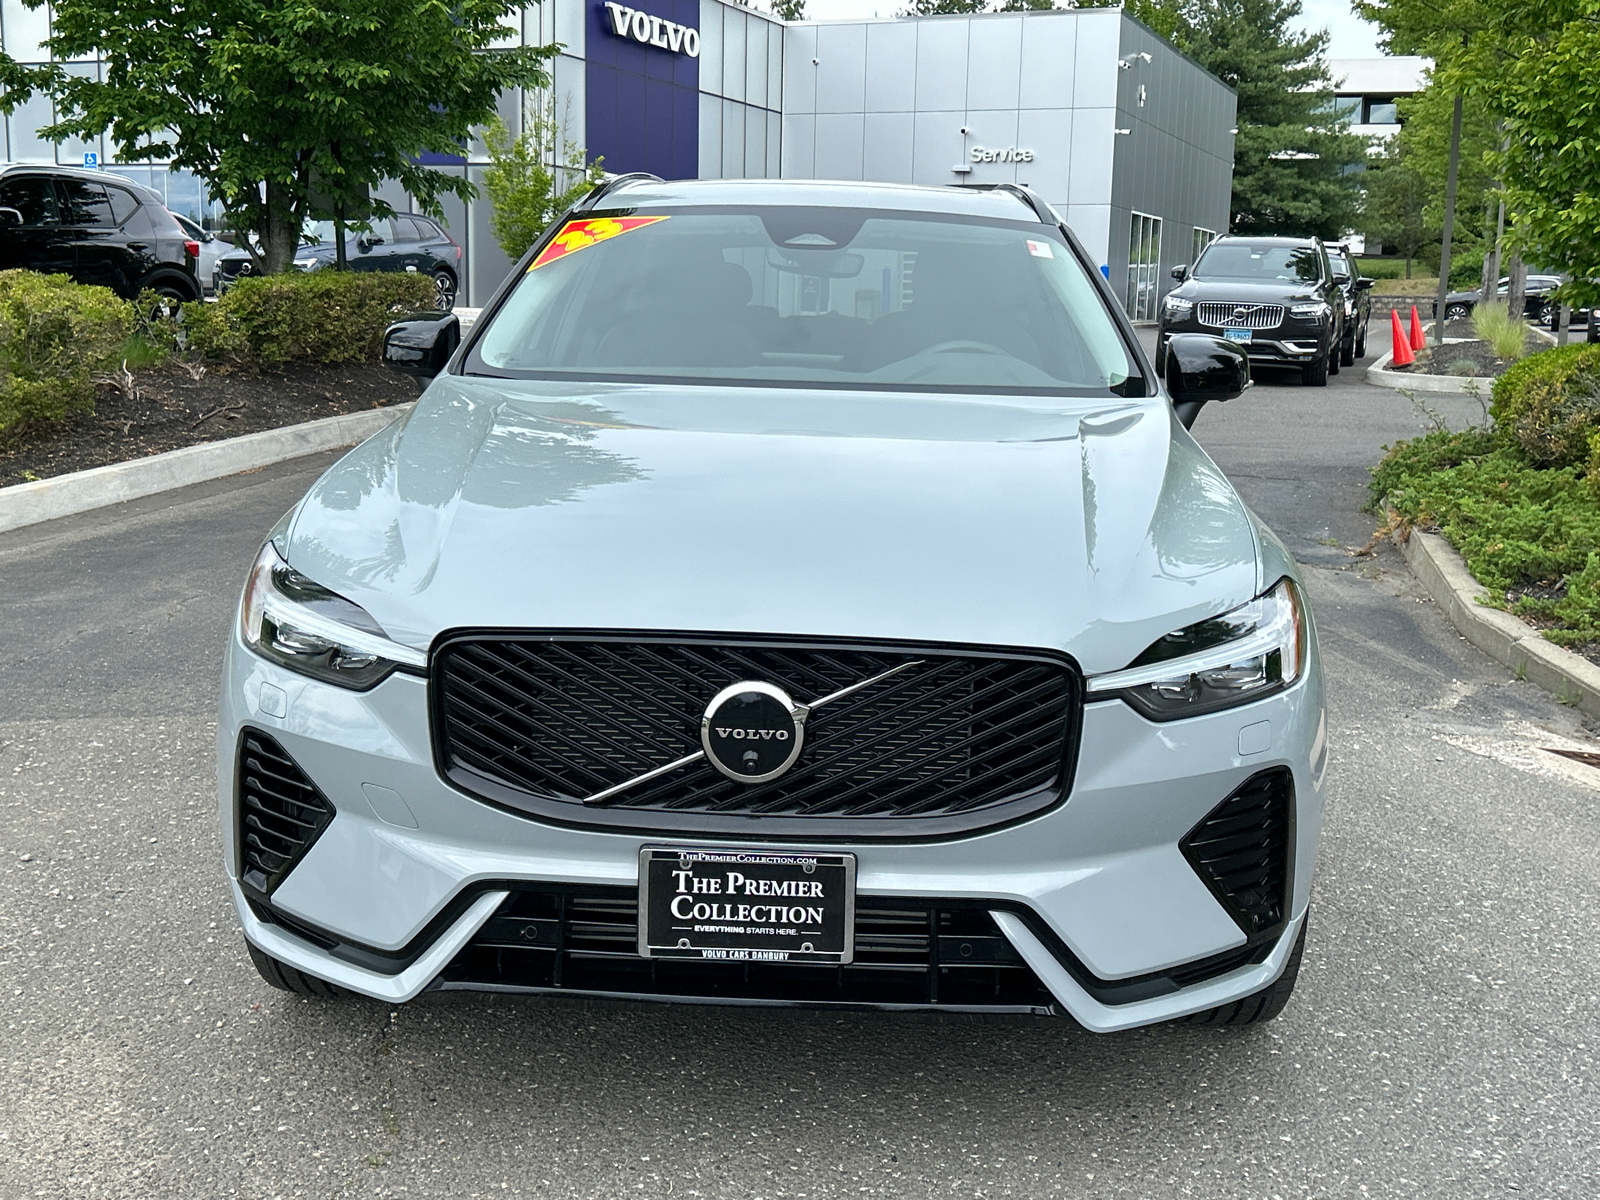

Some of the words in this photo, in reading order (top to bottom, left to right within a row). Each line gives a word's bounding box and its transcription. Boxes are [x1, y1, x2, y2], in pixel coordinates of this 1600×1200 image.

[604, 1, 700, 58] VOLVO
[970, 146, 1034, 163] Service
[556, 219, 623, 251] 23
[715, 727, 789, 740] VOLVO
[671, 870, 721, 894] THE
[726, 872, 824, 898] PREMIER
[670, 895, 824, 924] COLLECTION
[694, 925, 745, 934] EVERYTHING
[702, 950, 726, 959] VOLVO
[729, 950, 749, 960] CARS
[752, 951, 789, 960] DANBURY
